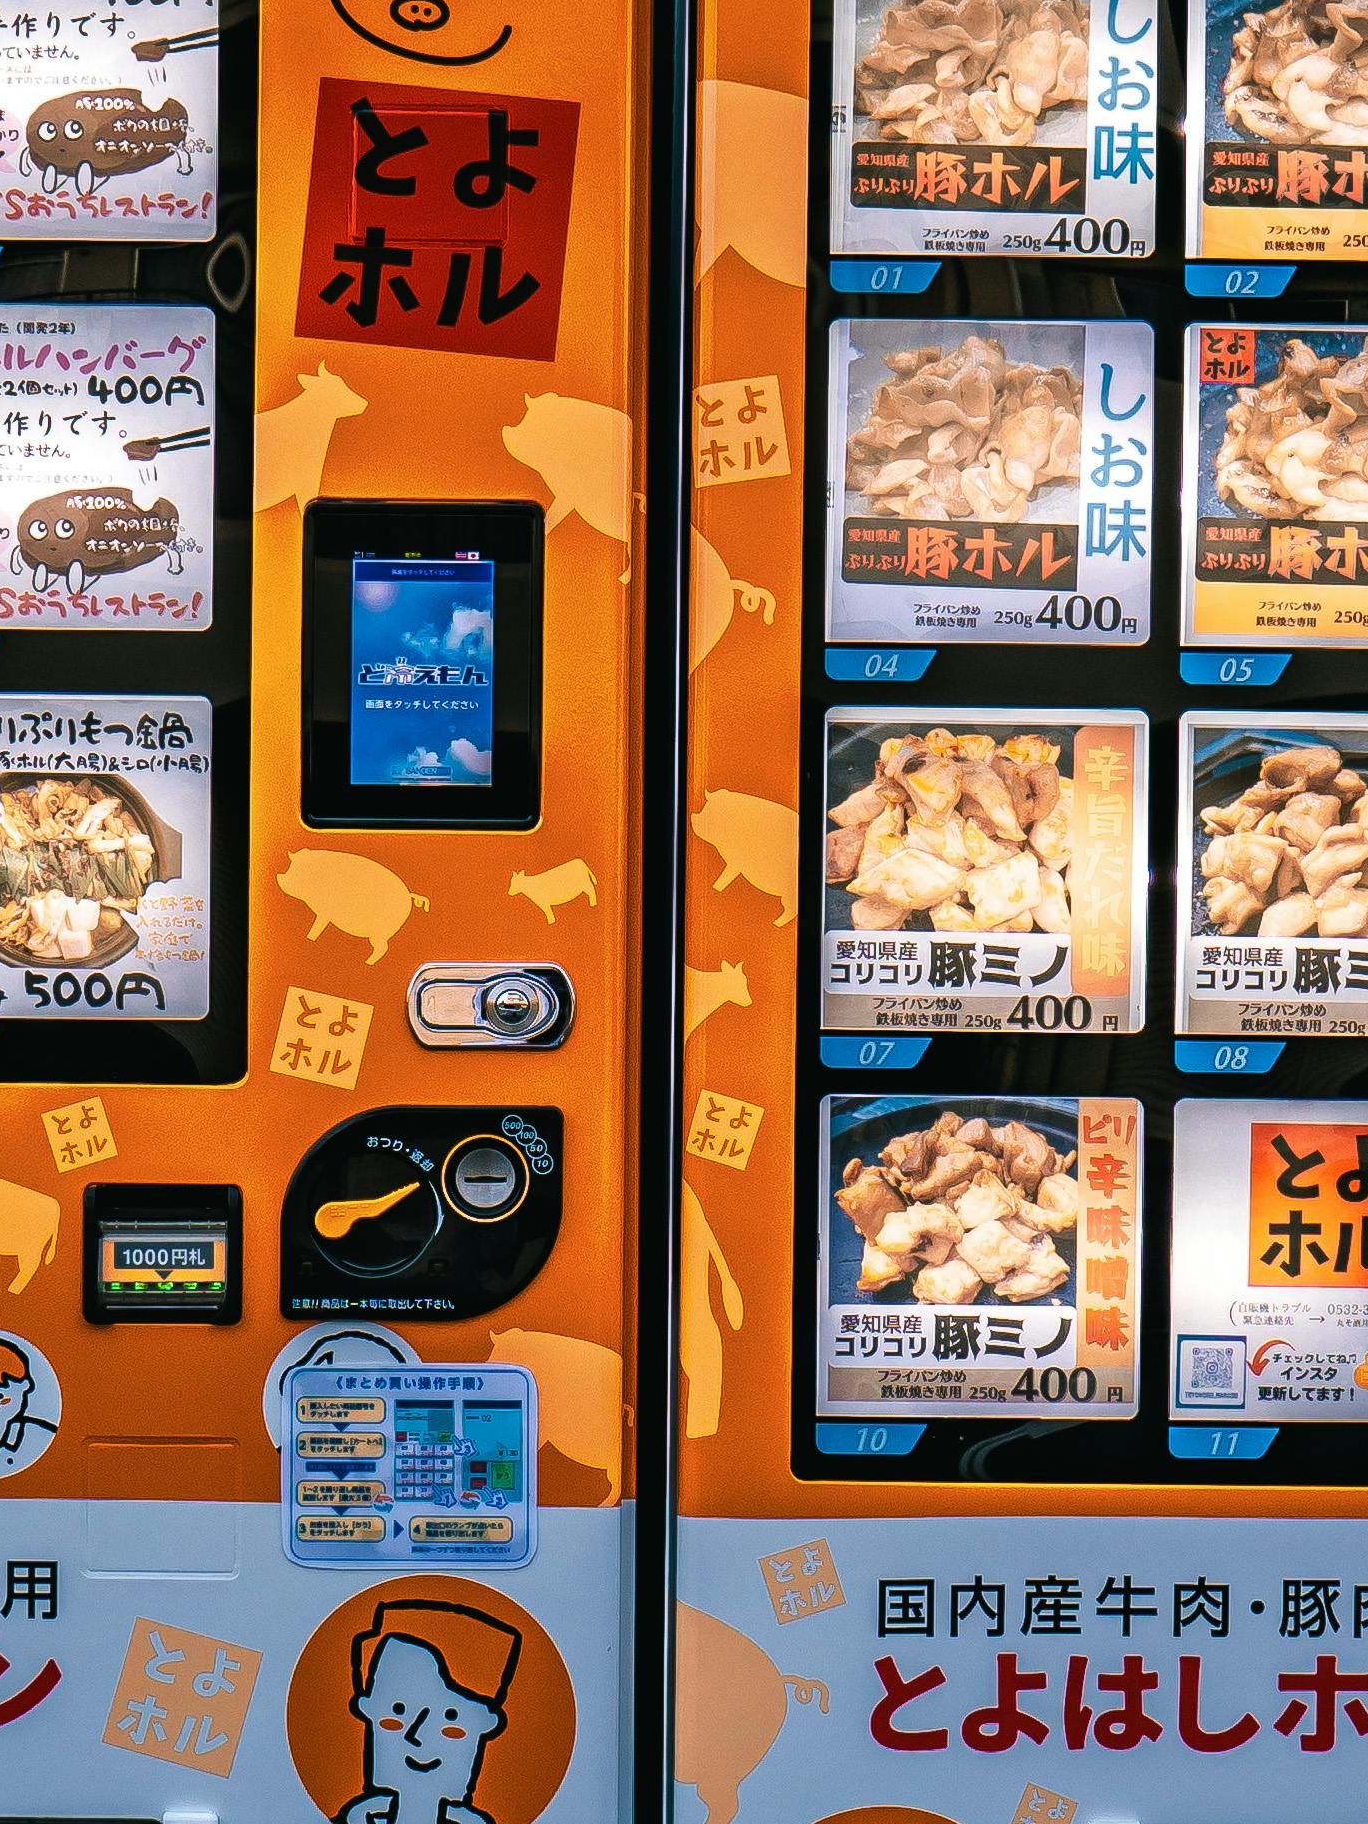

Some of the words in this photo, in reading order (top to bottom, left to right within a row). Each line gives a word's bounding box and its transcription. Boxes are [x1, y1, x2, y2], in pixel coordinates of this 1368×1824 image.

[351, 97, 539, 208] とよ
[853, 178, 913, 193] ぷりぷり
[913, 152, 1080, 206] 豚ホル
[1003, 236, 1042, 252] 250g
[319, 227, 540, 327] ホル
[870, 266, 903, 289] 01
[1225, 271, 1259, 294] 02
[88, 375, 206, 406] 400円
[696, 386, 767, 429] とよ
[700, 436, 778, 478] ホル
[1085, 363, 1147, 563] しお味
[905, 527, 1071, 581] 豚ホル
[865, 654, 898, 677] 04
[1219, 659, 1254, 682] 05
[366, 700, 479, 709] 画面をタッチしてください
[836, 941, 918, 960] 愛知県産
[1202, 947, 1283, 967] 愛知県産
[830, 963, 922, 984] コリコリ
[928, 941, 1068, 989] 豚ミノ
[24, 971, 166, 1010] 500円
[1196, 969, 1287, 991] コリコリ
[872, 997, 962, 1011] フライパン炒め
[1238, 1003, 1327, 1017] フライパン炒め
[876, 1012, 957, 1027] 鉄板焼き専用
[859, 1042, 895, 1066] 07
[1214, 1046, 1248, 1070] 08
[51, 1105, 98, 1135] とよ
[505, 1121, 520, 1130] 500
[520, 1131, 535, 1139] 100
[61, 1136, 108, 1163] ホル
[530, 1144, 543, 1153] 50
[537, 1159, 548, 1168] 10
[1083, 1114, 1136, 1351] ピリ辛味噌味
[122, 1248, 205, 1267] 1000円札
[840, 1314, 922, 1334] 愛知県産
[835, 1336, 926, 1358] コリコリ
[933, 1314, 1073, 1361] 豚ミノ
[1281, 1367, 1338, 1382] インスタ
[856, 1427, 888, 1452] 10
[1211, 1431, 1240, 1454] 11
[142, 1630, 243, 1695] とよ
[114, 1697, 230, 1758] ホル
